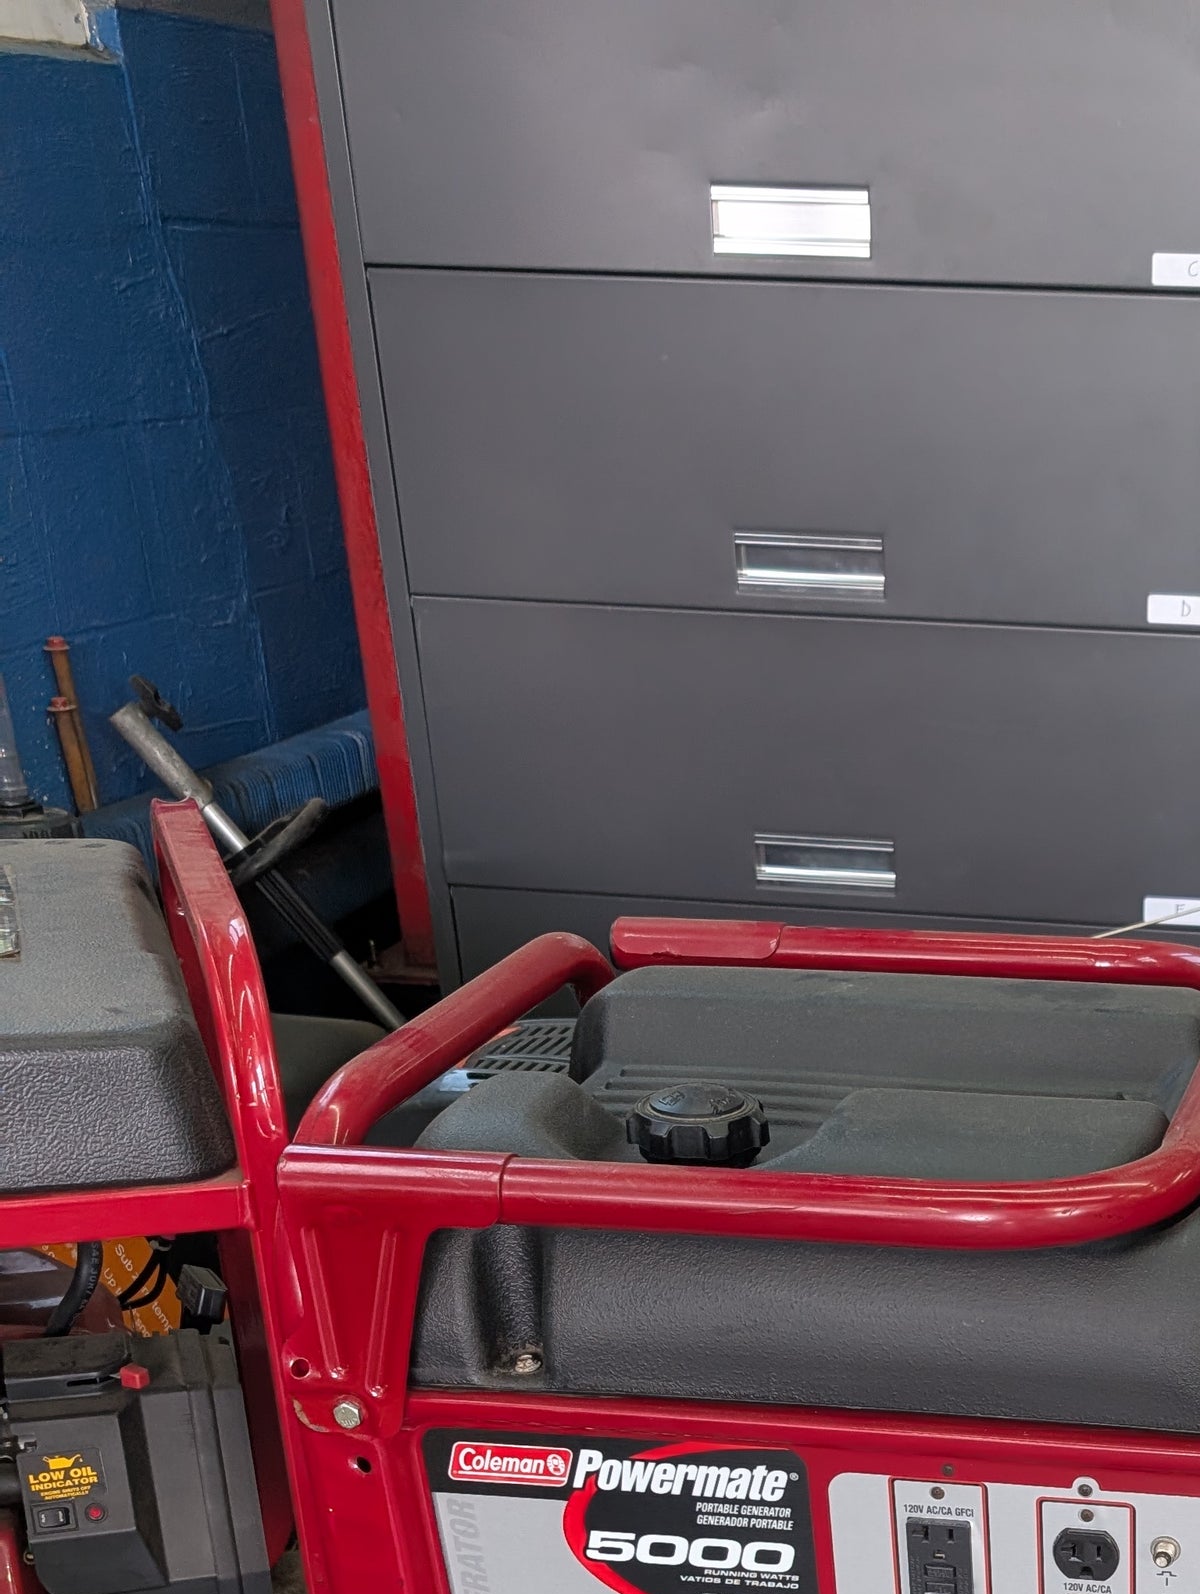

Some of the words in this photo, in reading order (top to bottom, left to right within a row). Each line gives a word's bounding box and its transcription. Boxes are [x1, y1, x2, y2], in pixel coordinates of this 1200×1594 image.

[1188, 260, 1199, 277] C
[114, 1244, 134, 1272] Sub
[104, 1267, 116, 1288] Up
[458, 1447, 544, 1474] Coleman
[28, 1470, 66, 1484] LOW
[69, 1466, 97, 1478] OIL
[30, 1476, 98, 1492] INDICATOR
[696, 1502, 740, 1514] PORTABLE
[740, 1505, 792, 1518] GENERATOR
[904, 1504, 924, 1514] 120V
[926, 1505, 953, 1516] AC/CA
[954, 1508, 974, 1518] GFCI
[696, 1514, 749, 1528] GENERADOR
[750, 1518, 794, 1530] PORTABLE
[586, 1530, 796, 1573] 5000
[680, 1574, 722, 1584] VATIOS
[724, 1578, 741, 1586] DE
[744, 1580, 800, 1590] TRABAJO
[704, 1569, 758, 1578] RUNNING
[760, 1572, 800, 1582] WATTS
[1064, 1582, 1084, 1592] 120V
[1086, 1584, 1112, 1594] AC/CA
